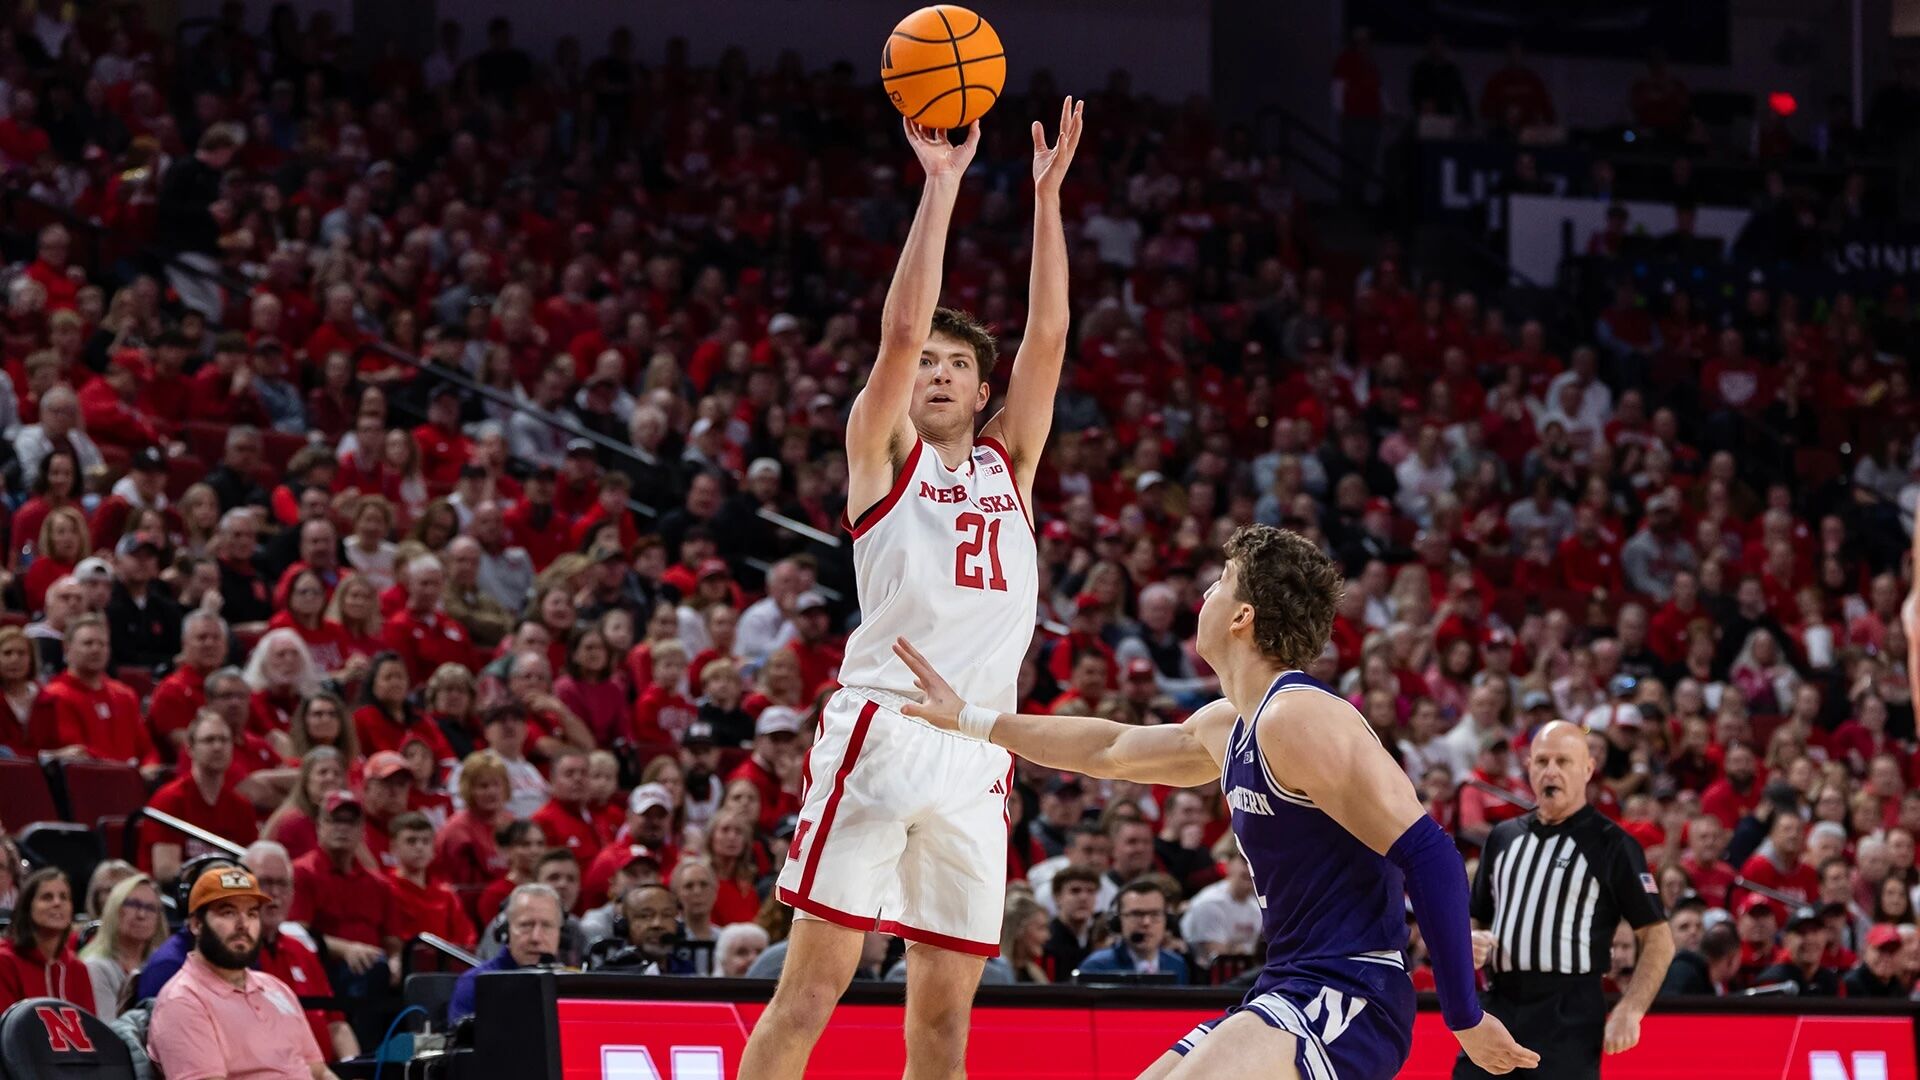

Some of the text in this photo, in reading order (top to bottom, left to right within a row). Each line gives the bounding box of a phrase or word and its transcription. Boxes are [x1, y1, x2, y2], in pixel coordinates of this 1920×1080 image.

[918, 480, 1018, 513] NEBSKA
[955, 512, 1008, 592] 21
[35, 1006, 96, 1052] N
